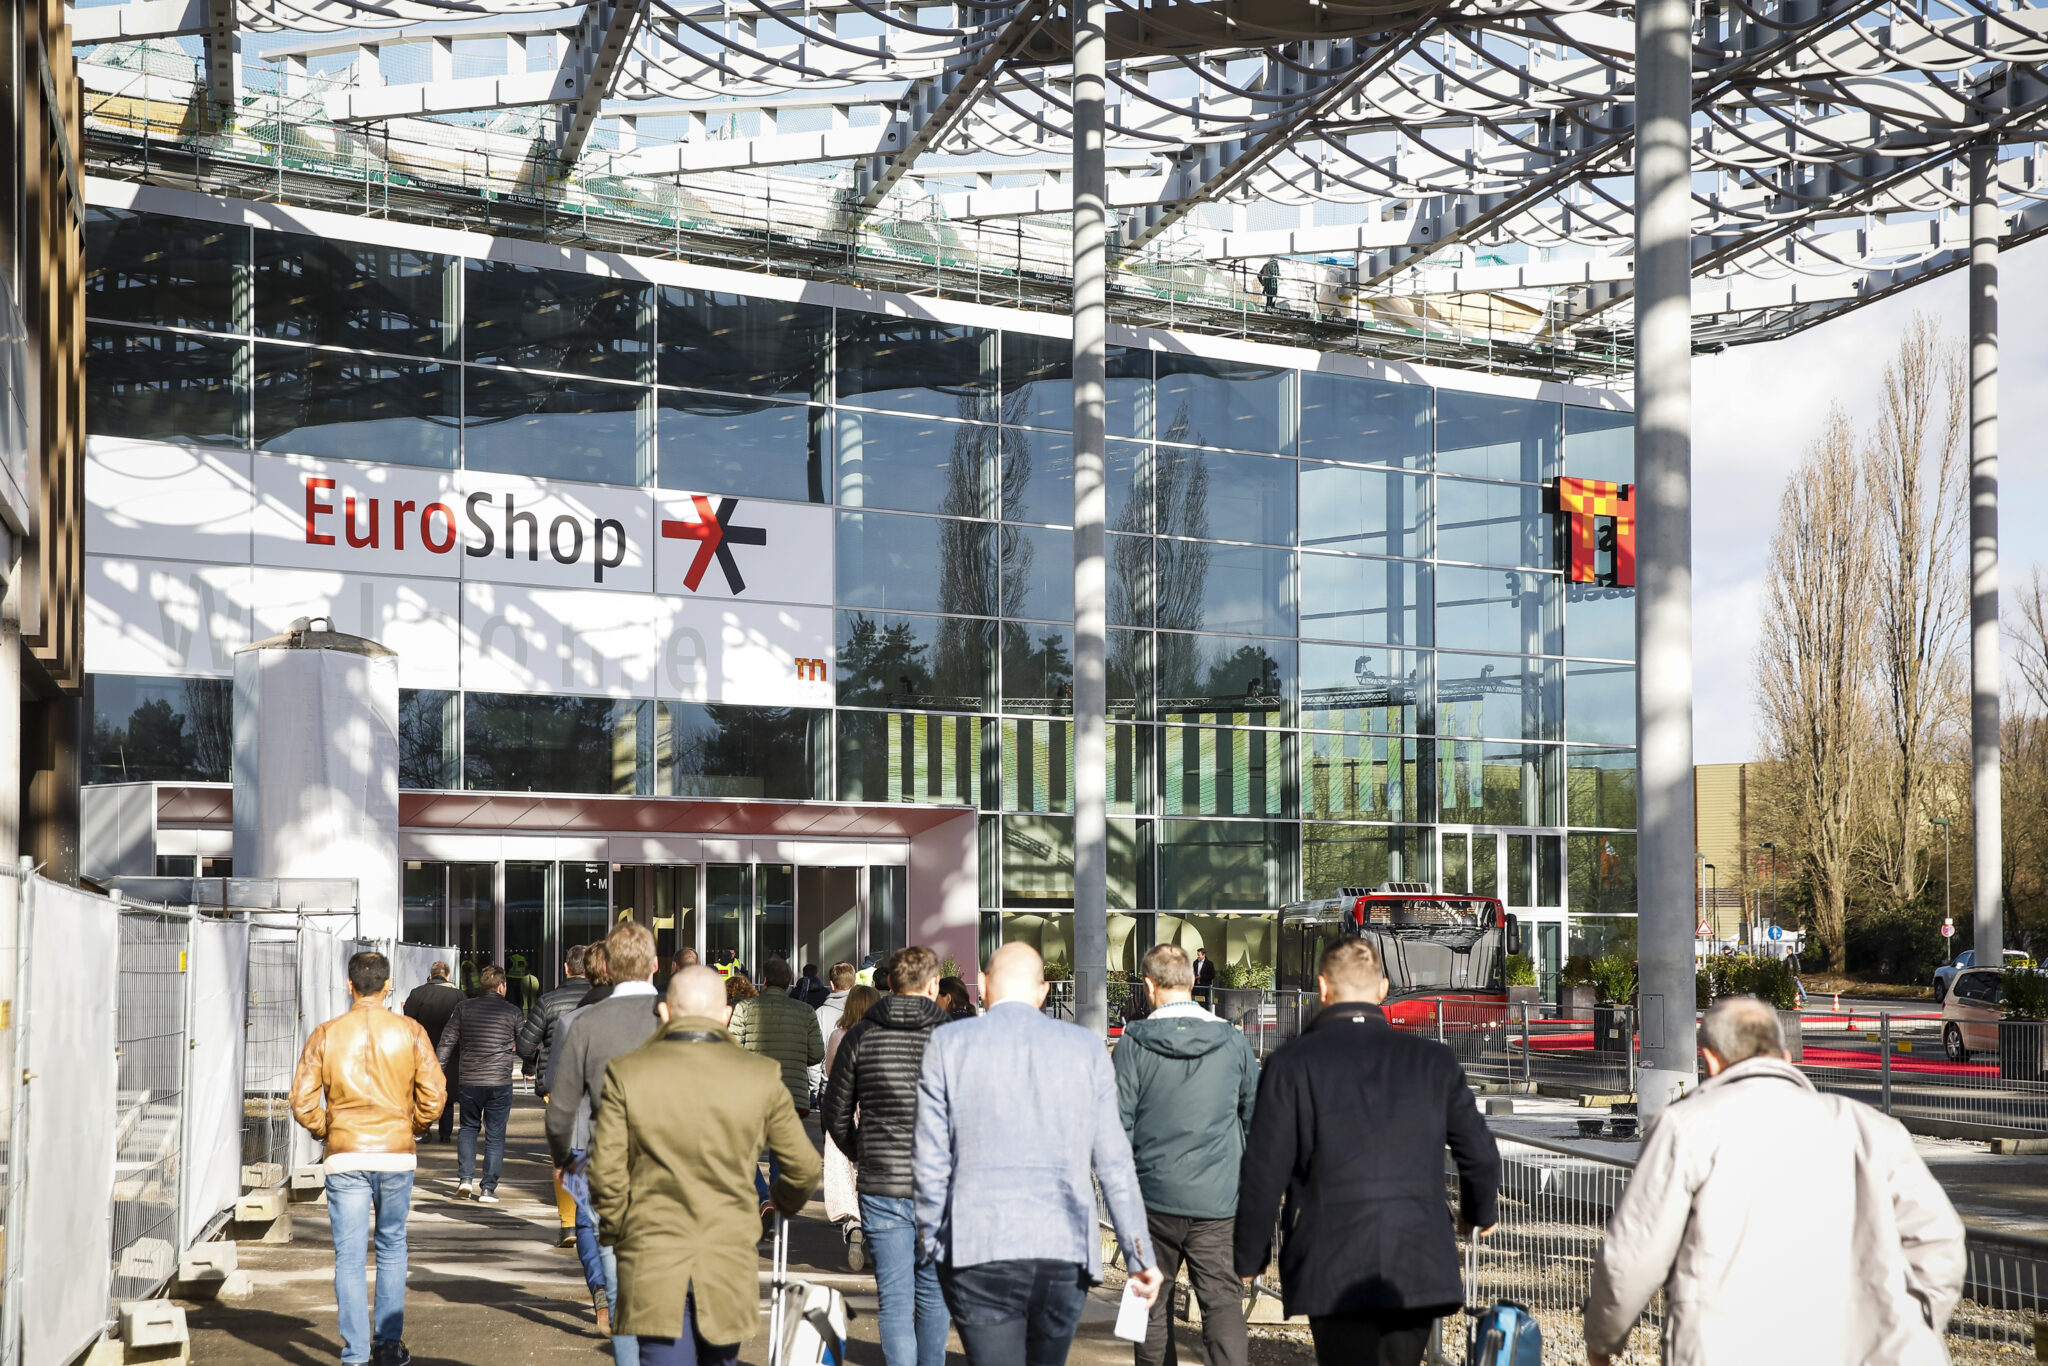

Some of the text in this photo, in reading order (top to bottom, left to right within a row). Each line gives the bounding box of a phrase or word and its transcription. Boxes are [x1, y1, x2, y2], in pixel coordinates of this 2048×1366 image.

[193, 146, 215, 154] TKUS
[305, 477, 626, 583] EuroShop
[159, 572, 707, 694] Wloe
